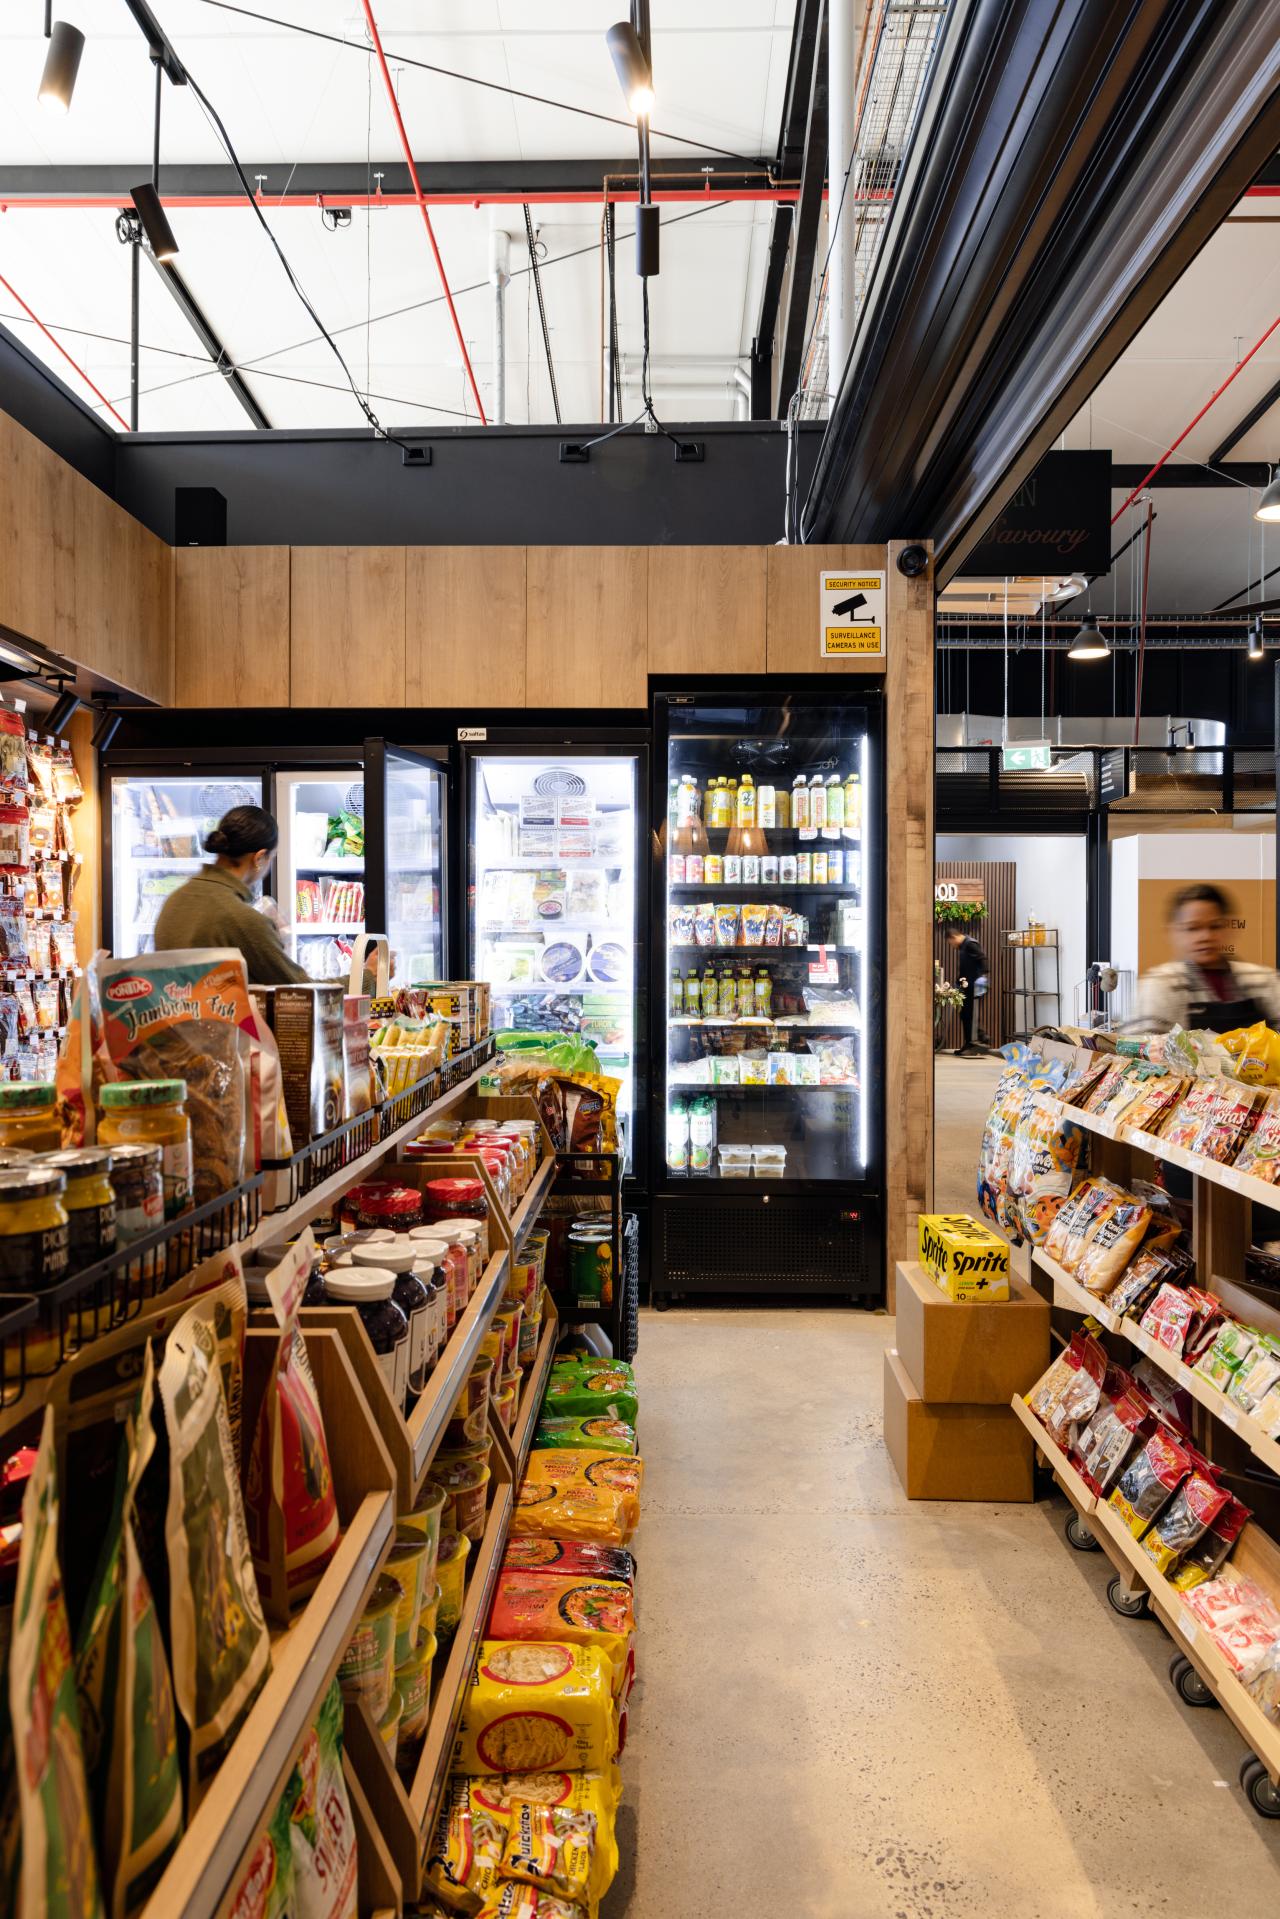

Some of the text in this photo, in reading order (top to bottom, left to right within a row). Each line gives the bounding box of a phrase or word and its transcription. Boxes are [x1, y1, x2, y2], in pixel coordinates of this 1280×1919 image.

[207, 994, 237, 1020] Fish
[922, 1226, 947, 1273] Sprite
[956, 1293, 966, 1301] 10
[567, 1847, 579, 1877] CHICKEN
